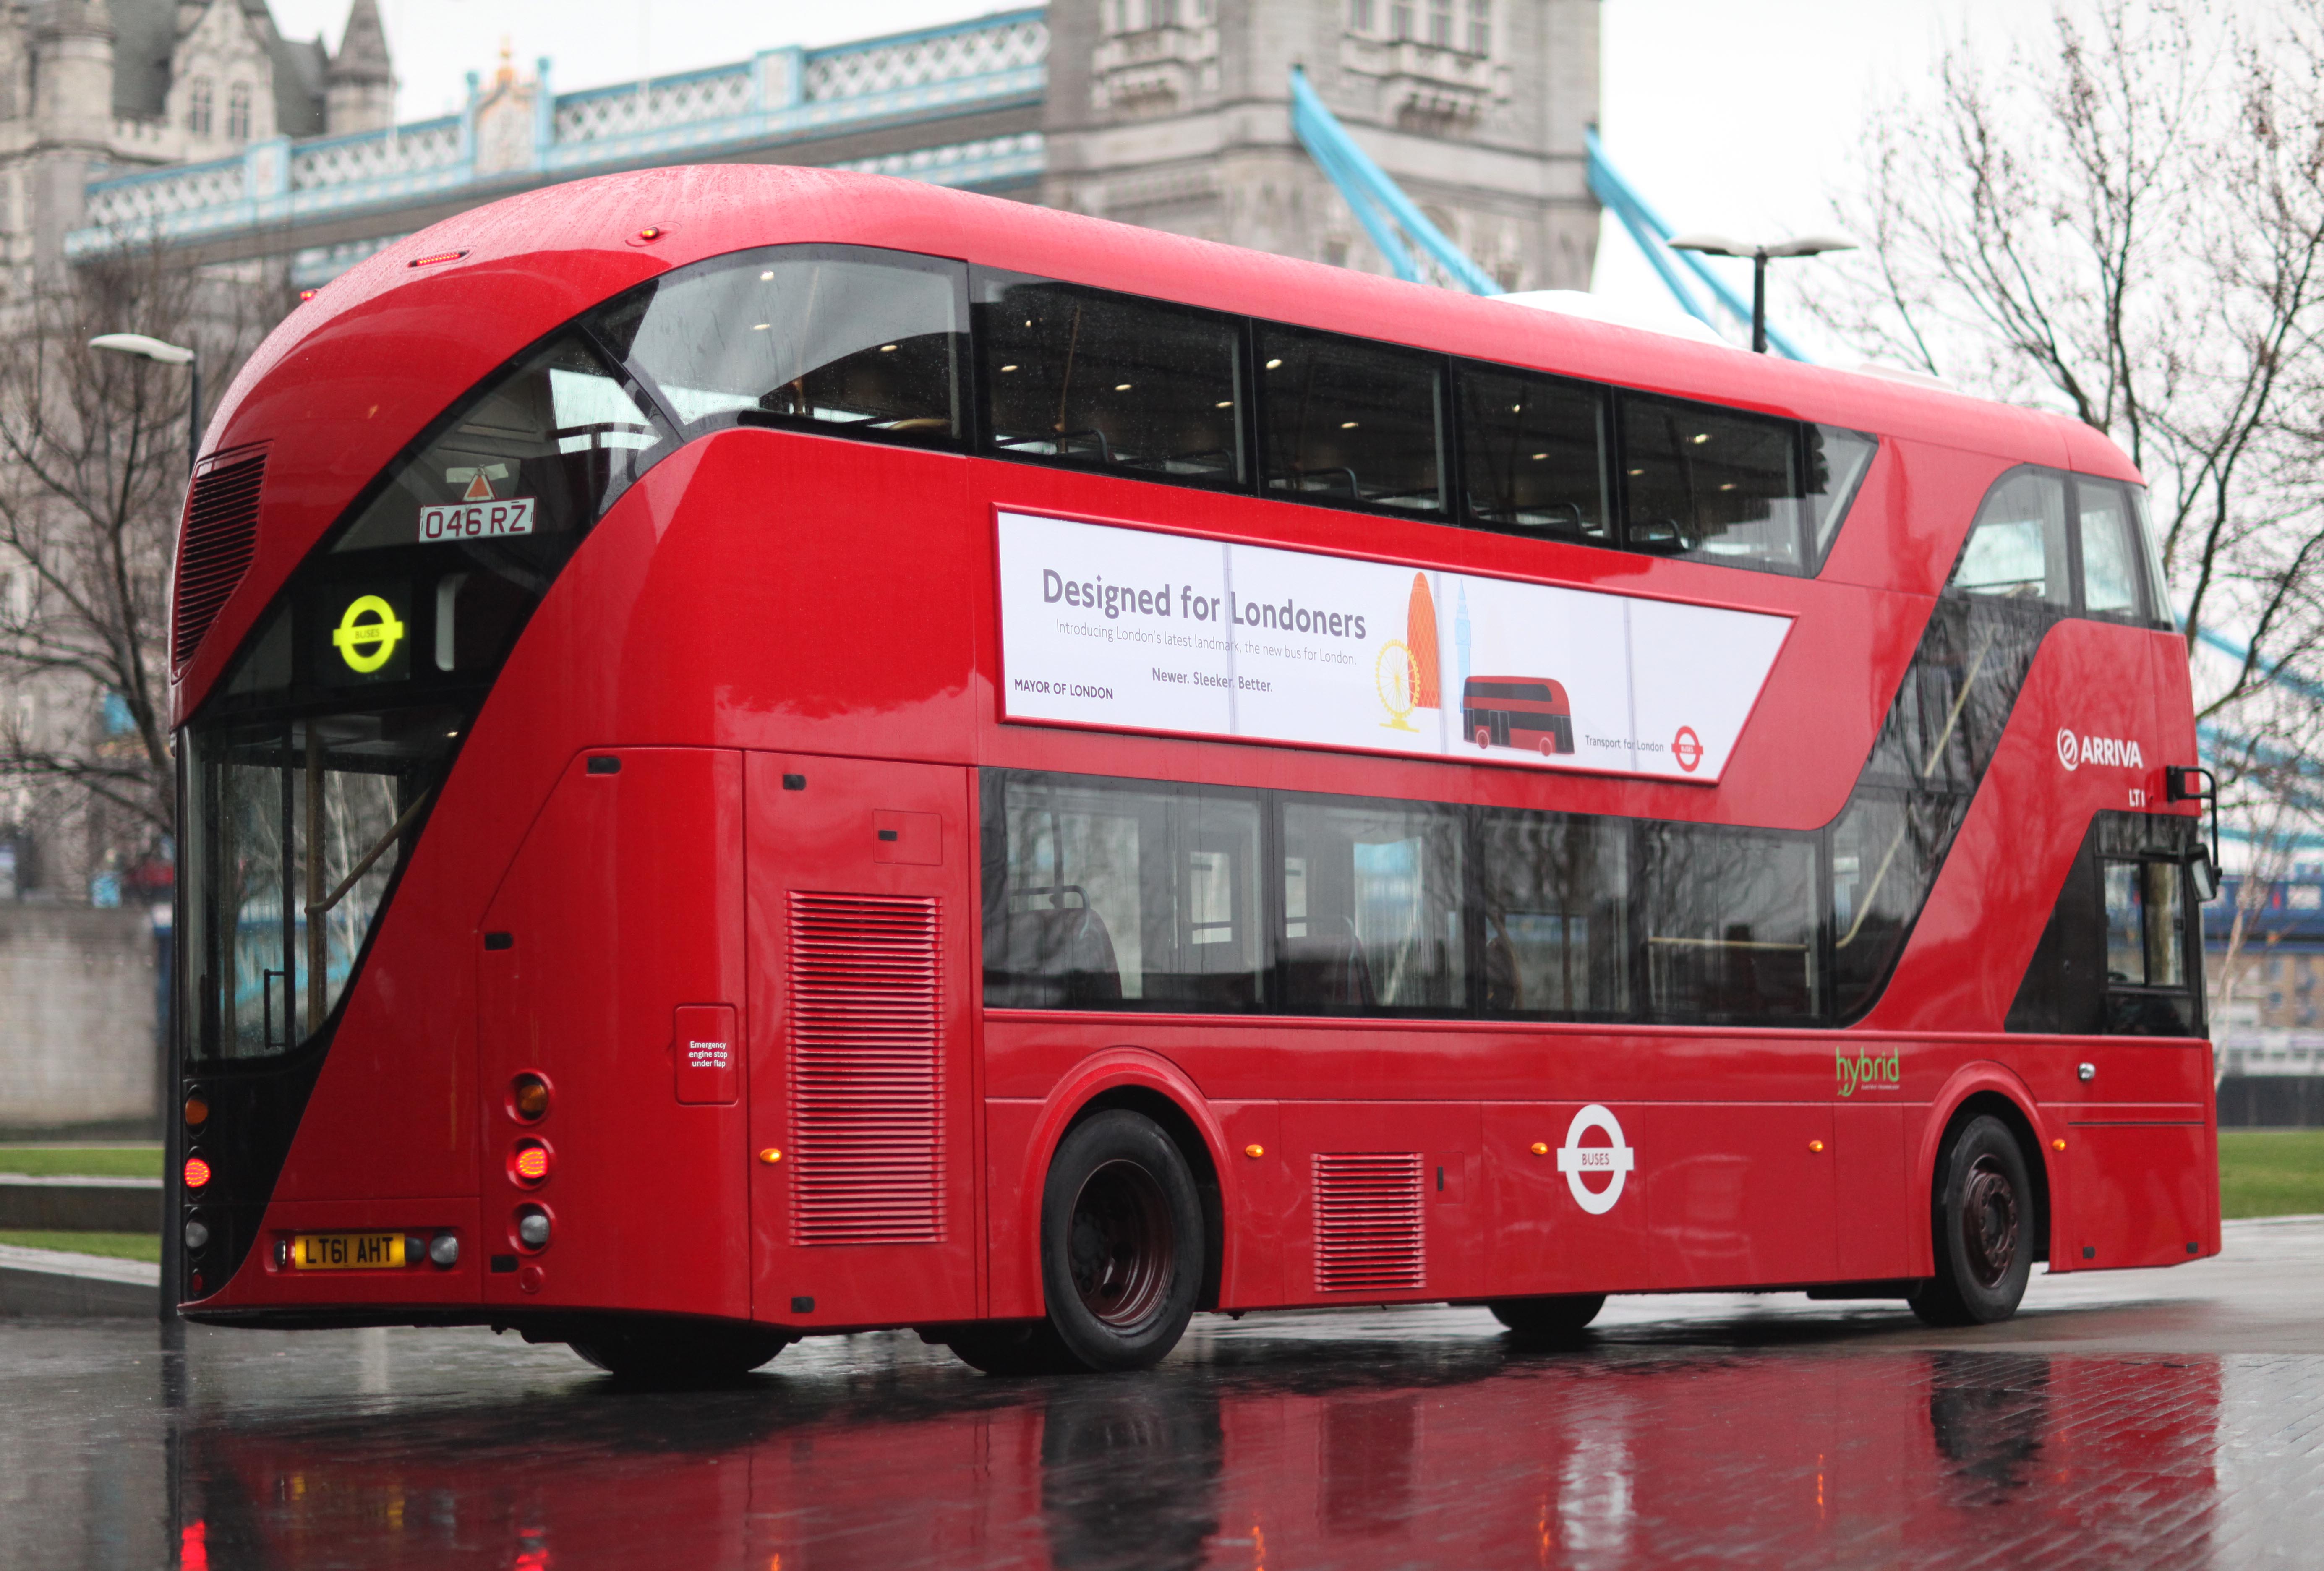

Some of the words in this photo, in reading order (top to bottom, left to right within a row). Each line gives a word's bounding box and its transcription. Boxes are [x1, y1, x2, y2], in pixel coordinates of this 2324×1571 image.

[490, 504, 527, 534] RZ
[1043, 569, 1171, 619] Designed
[1180, 585, 1220, 622] for
[1230, 591, 1366, 639] Londoners
[355, 629, 380, 639] BUSES
[1056, 618, 1114, 642] Introducing
[1116, 625, 1162, 644] London's
[1164, 631, 1193, 647] latest
[1195, 634, 1242, 653] landmark,
[1245, 640, 1260, 655] the
[1263, 645, 1282, 656] new
[1285, 644, 1301, 659] bus
[1303, 647, 1317, 660] for
[1319, 648, 1357, 665] London.
[1014, 679, 1050, 694] MAYOR
[1053, 682, 1066, 695] OF
[1070, 684, 1113, 699] LONDON
[1152, 667, 1190, 684] Newer.
[1193, 671, 1235, 688] Sleeker.
[1238, 676, 1273, 692] Better.
[1585, 735, 1621, 750] Transport
[1624, 739, 1635, 749] for
[1637, 740, 1664, 752] London
[2081, 736, 2143, 769] ARRIVA
[689, 1050, 712, 1059] engine
[714, 1051, 728, 1059] stop
[690, 1041, 726, 1050] Emergency
[714, 1059, 726, 1068] flap
[1836, 1046, 1900, 1097] hybrid
[1582, 1153, 1609, 1165] BUSES
[306, 1238, 348, 1264] LT61
[357, 1237, 394, 1263] AHT
